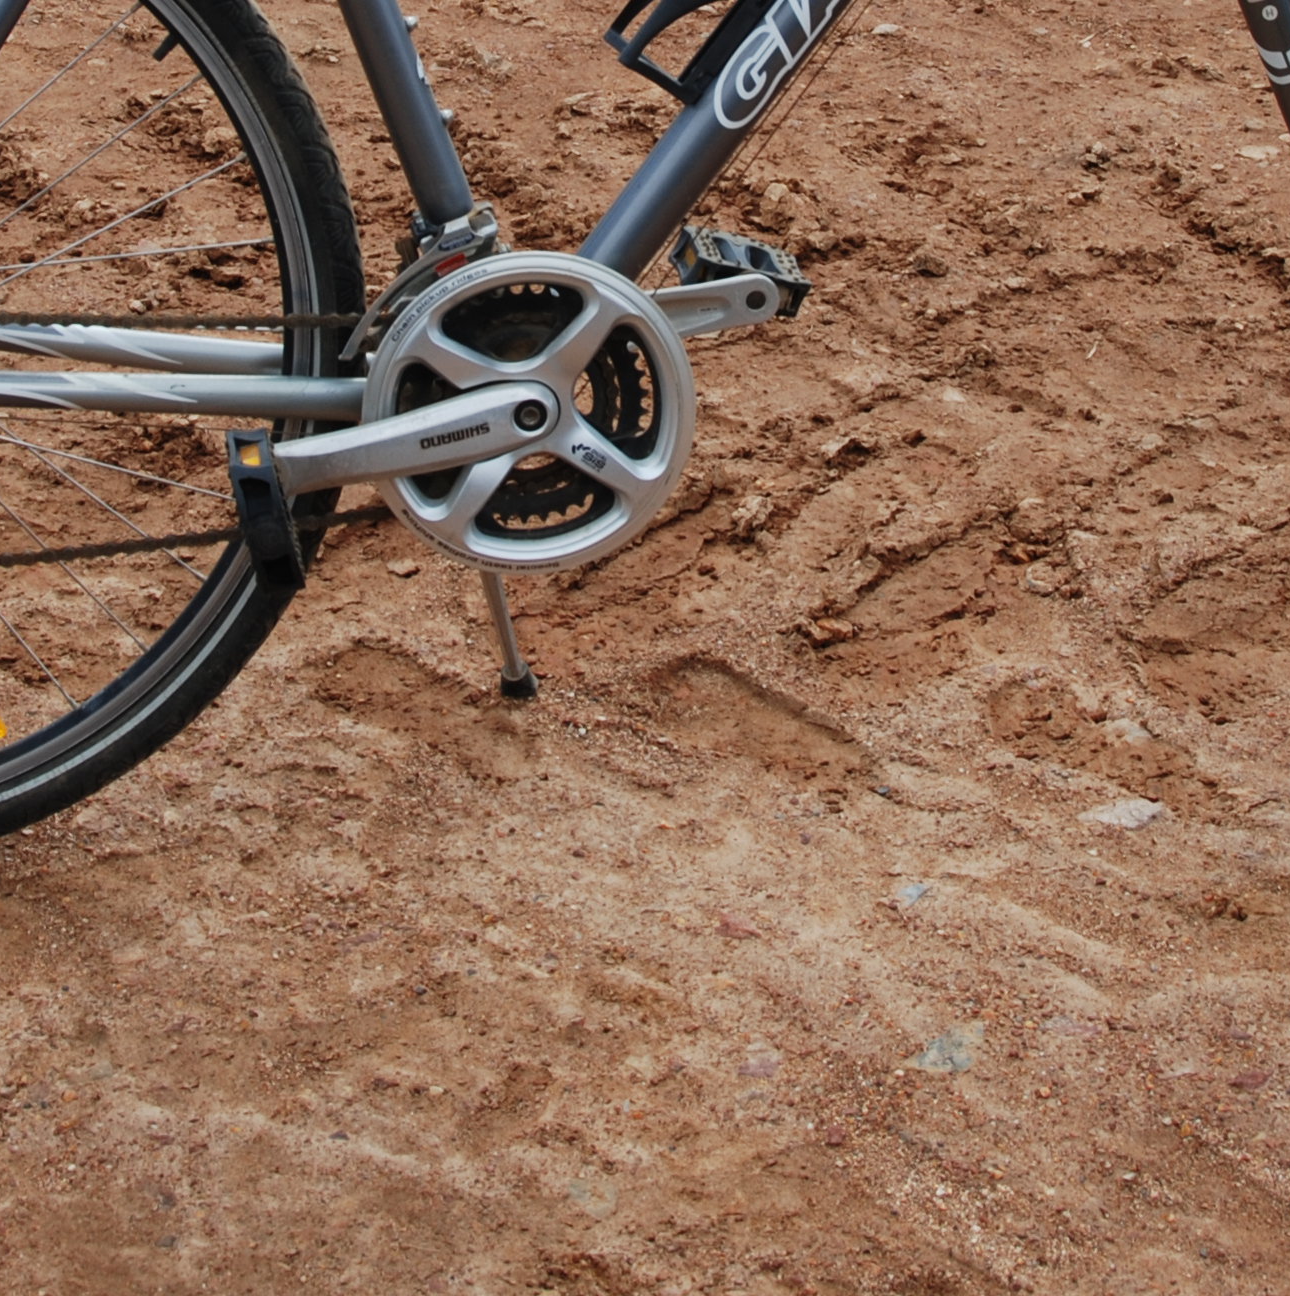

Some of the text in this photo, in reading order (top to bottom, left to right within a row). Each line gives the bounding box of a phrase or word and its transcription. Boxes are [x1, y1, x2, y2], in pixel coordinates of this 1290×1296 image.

[391, 313, 416, 342] Chain
[416, 286, 449, 313] pickup
[420, 422, 490, 449] SHIMANO
